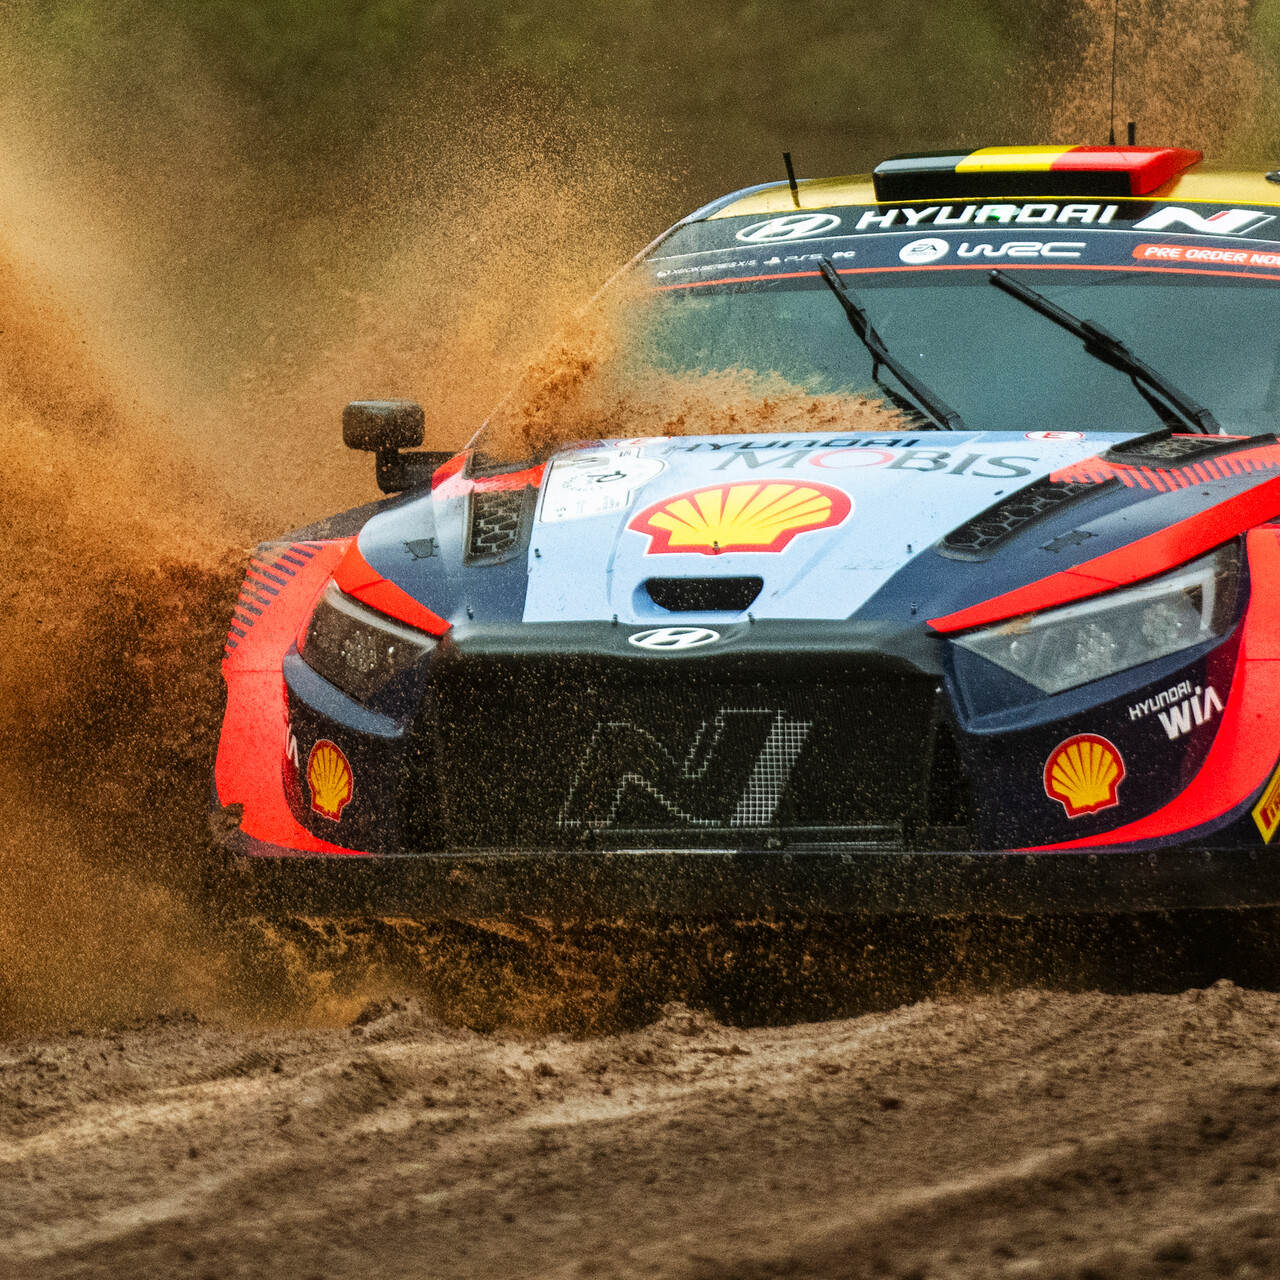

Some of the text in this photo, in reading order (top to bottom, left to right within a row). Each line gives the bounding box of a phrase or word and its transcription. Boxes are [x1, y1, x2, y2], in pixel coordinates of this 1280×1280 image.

[854, 203, 1119, 230] HYUNDAI
[832, 250, 857, 260] PC
[910, 243, 938, 252] EA
[956, 241, 1087, 258] WRC
[1144, 246, 1180, 259] PRE
[1184, 248, 1247, 263] ORDER
[661, 437, 921, 455] HYUNDAI
[711, 448, 1039, 479] MOBIS
[1128, 679, 1192, 721] HYUNDAI
